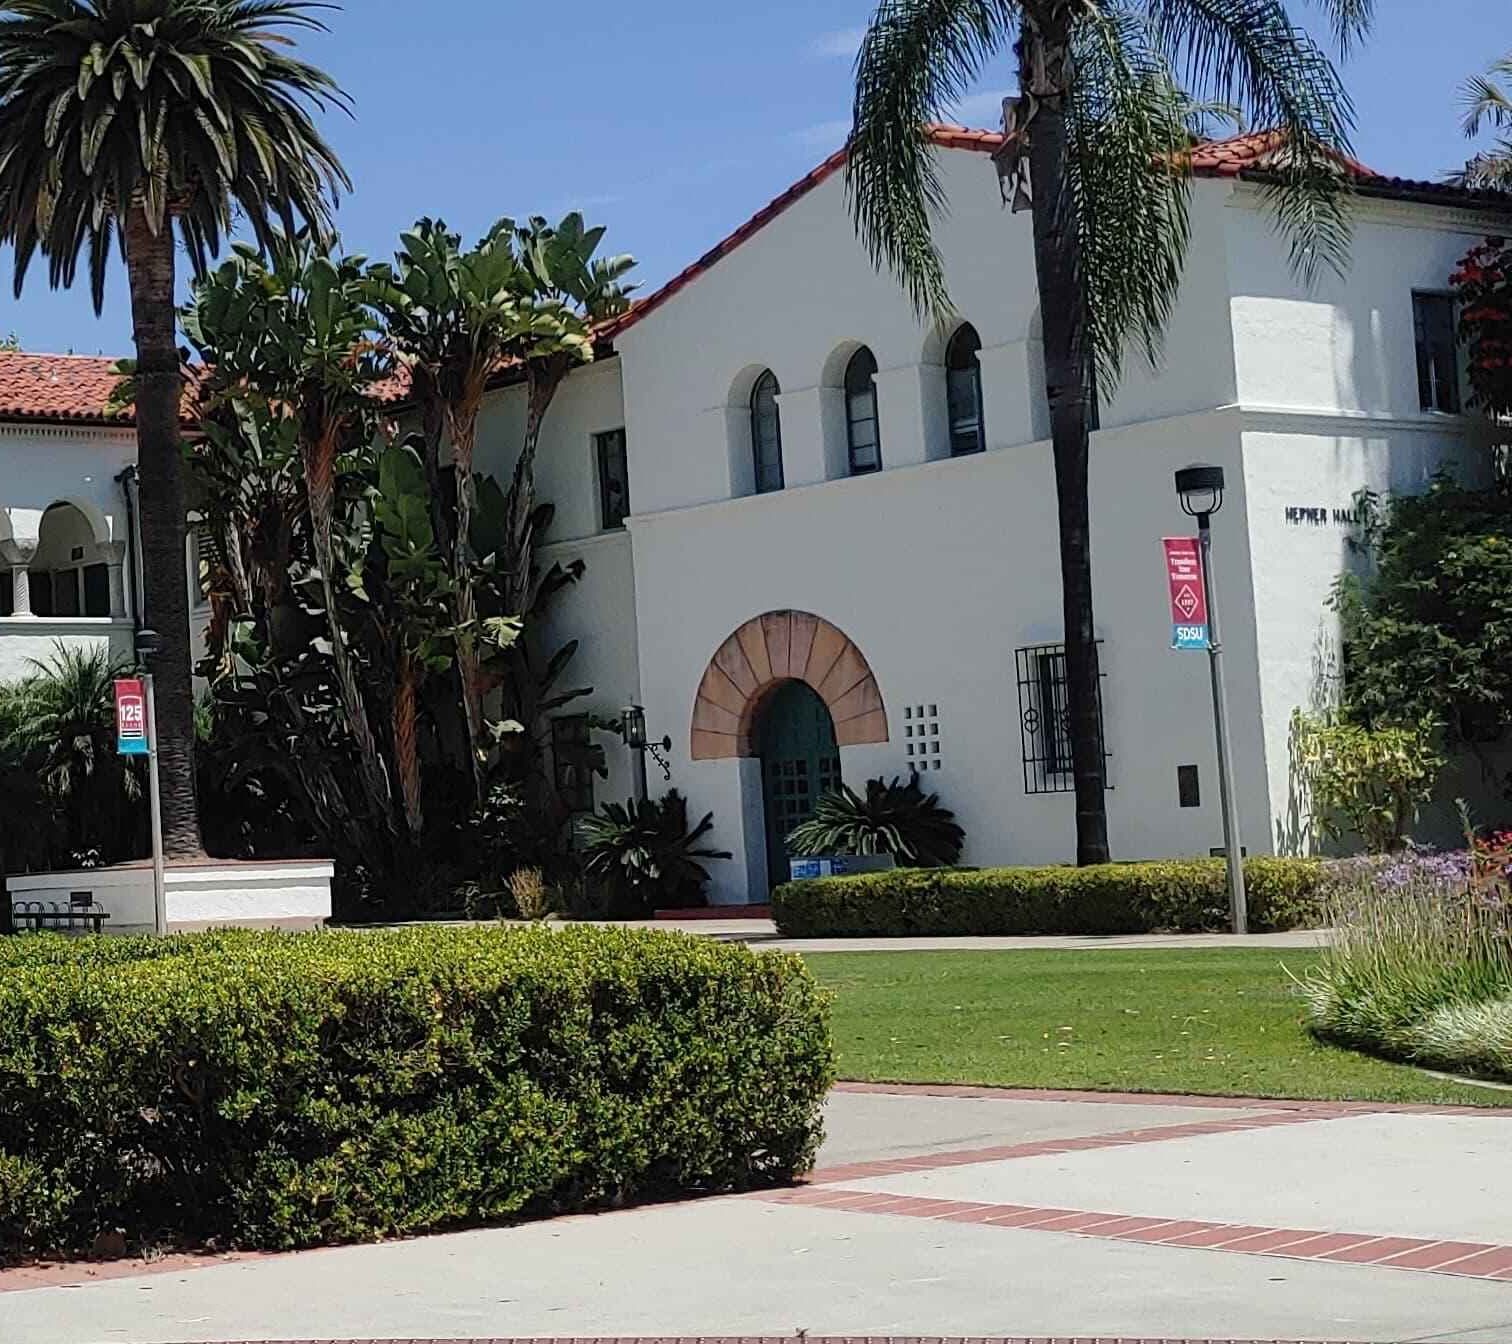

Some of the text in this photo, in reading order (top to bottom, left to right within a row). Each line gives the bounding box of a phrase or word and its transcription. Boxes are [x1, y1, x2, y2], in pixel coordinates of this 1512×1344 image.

[1332, 509, 1360, 525] HALL
[1176, 627, 1203, 640] SDSU
[121, 704, 142, 721] 125
